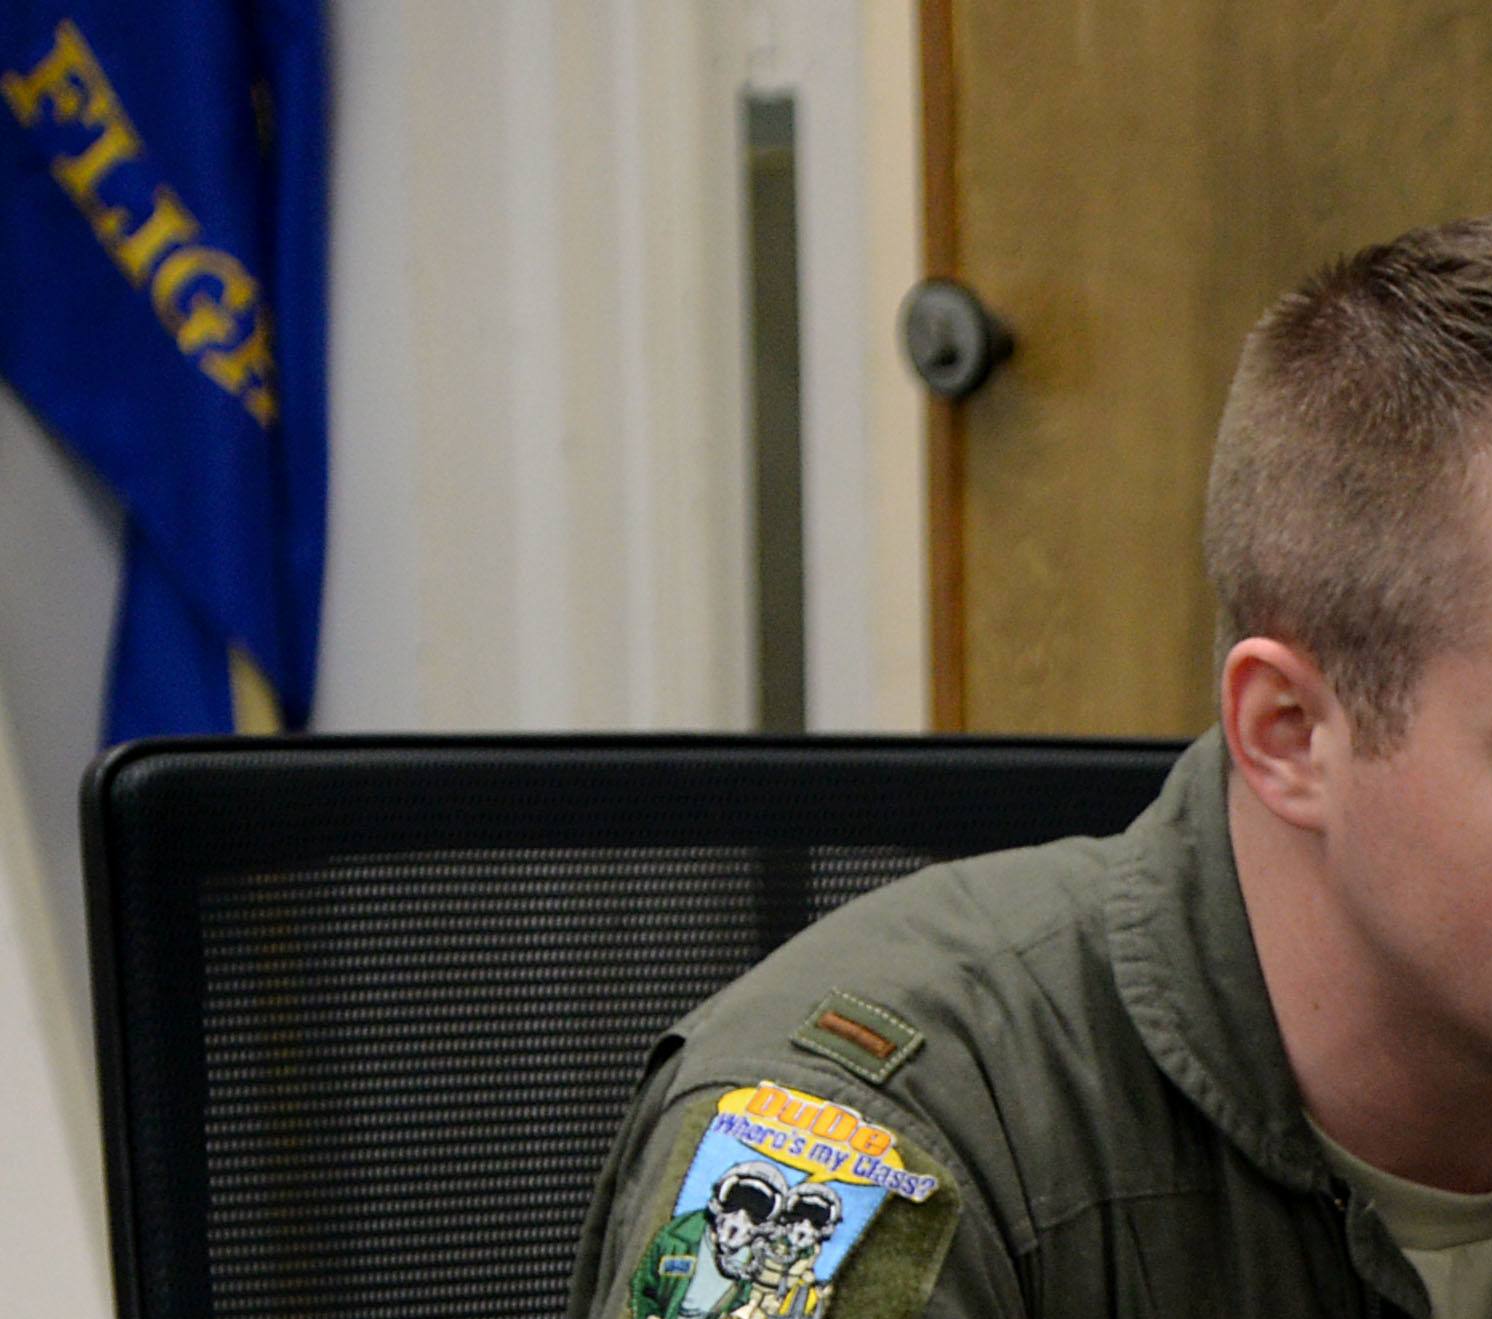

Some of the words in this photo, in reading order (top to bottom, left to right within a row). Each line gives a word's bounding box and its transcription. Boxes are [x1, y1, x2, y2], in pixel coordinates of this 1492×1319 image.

[714, 1111, 805, 1156] Where's
[810, 1140, 848, 1172] my
[853, 1153, 938, 1202] Class?
